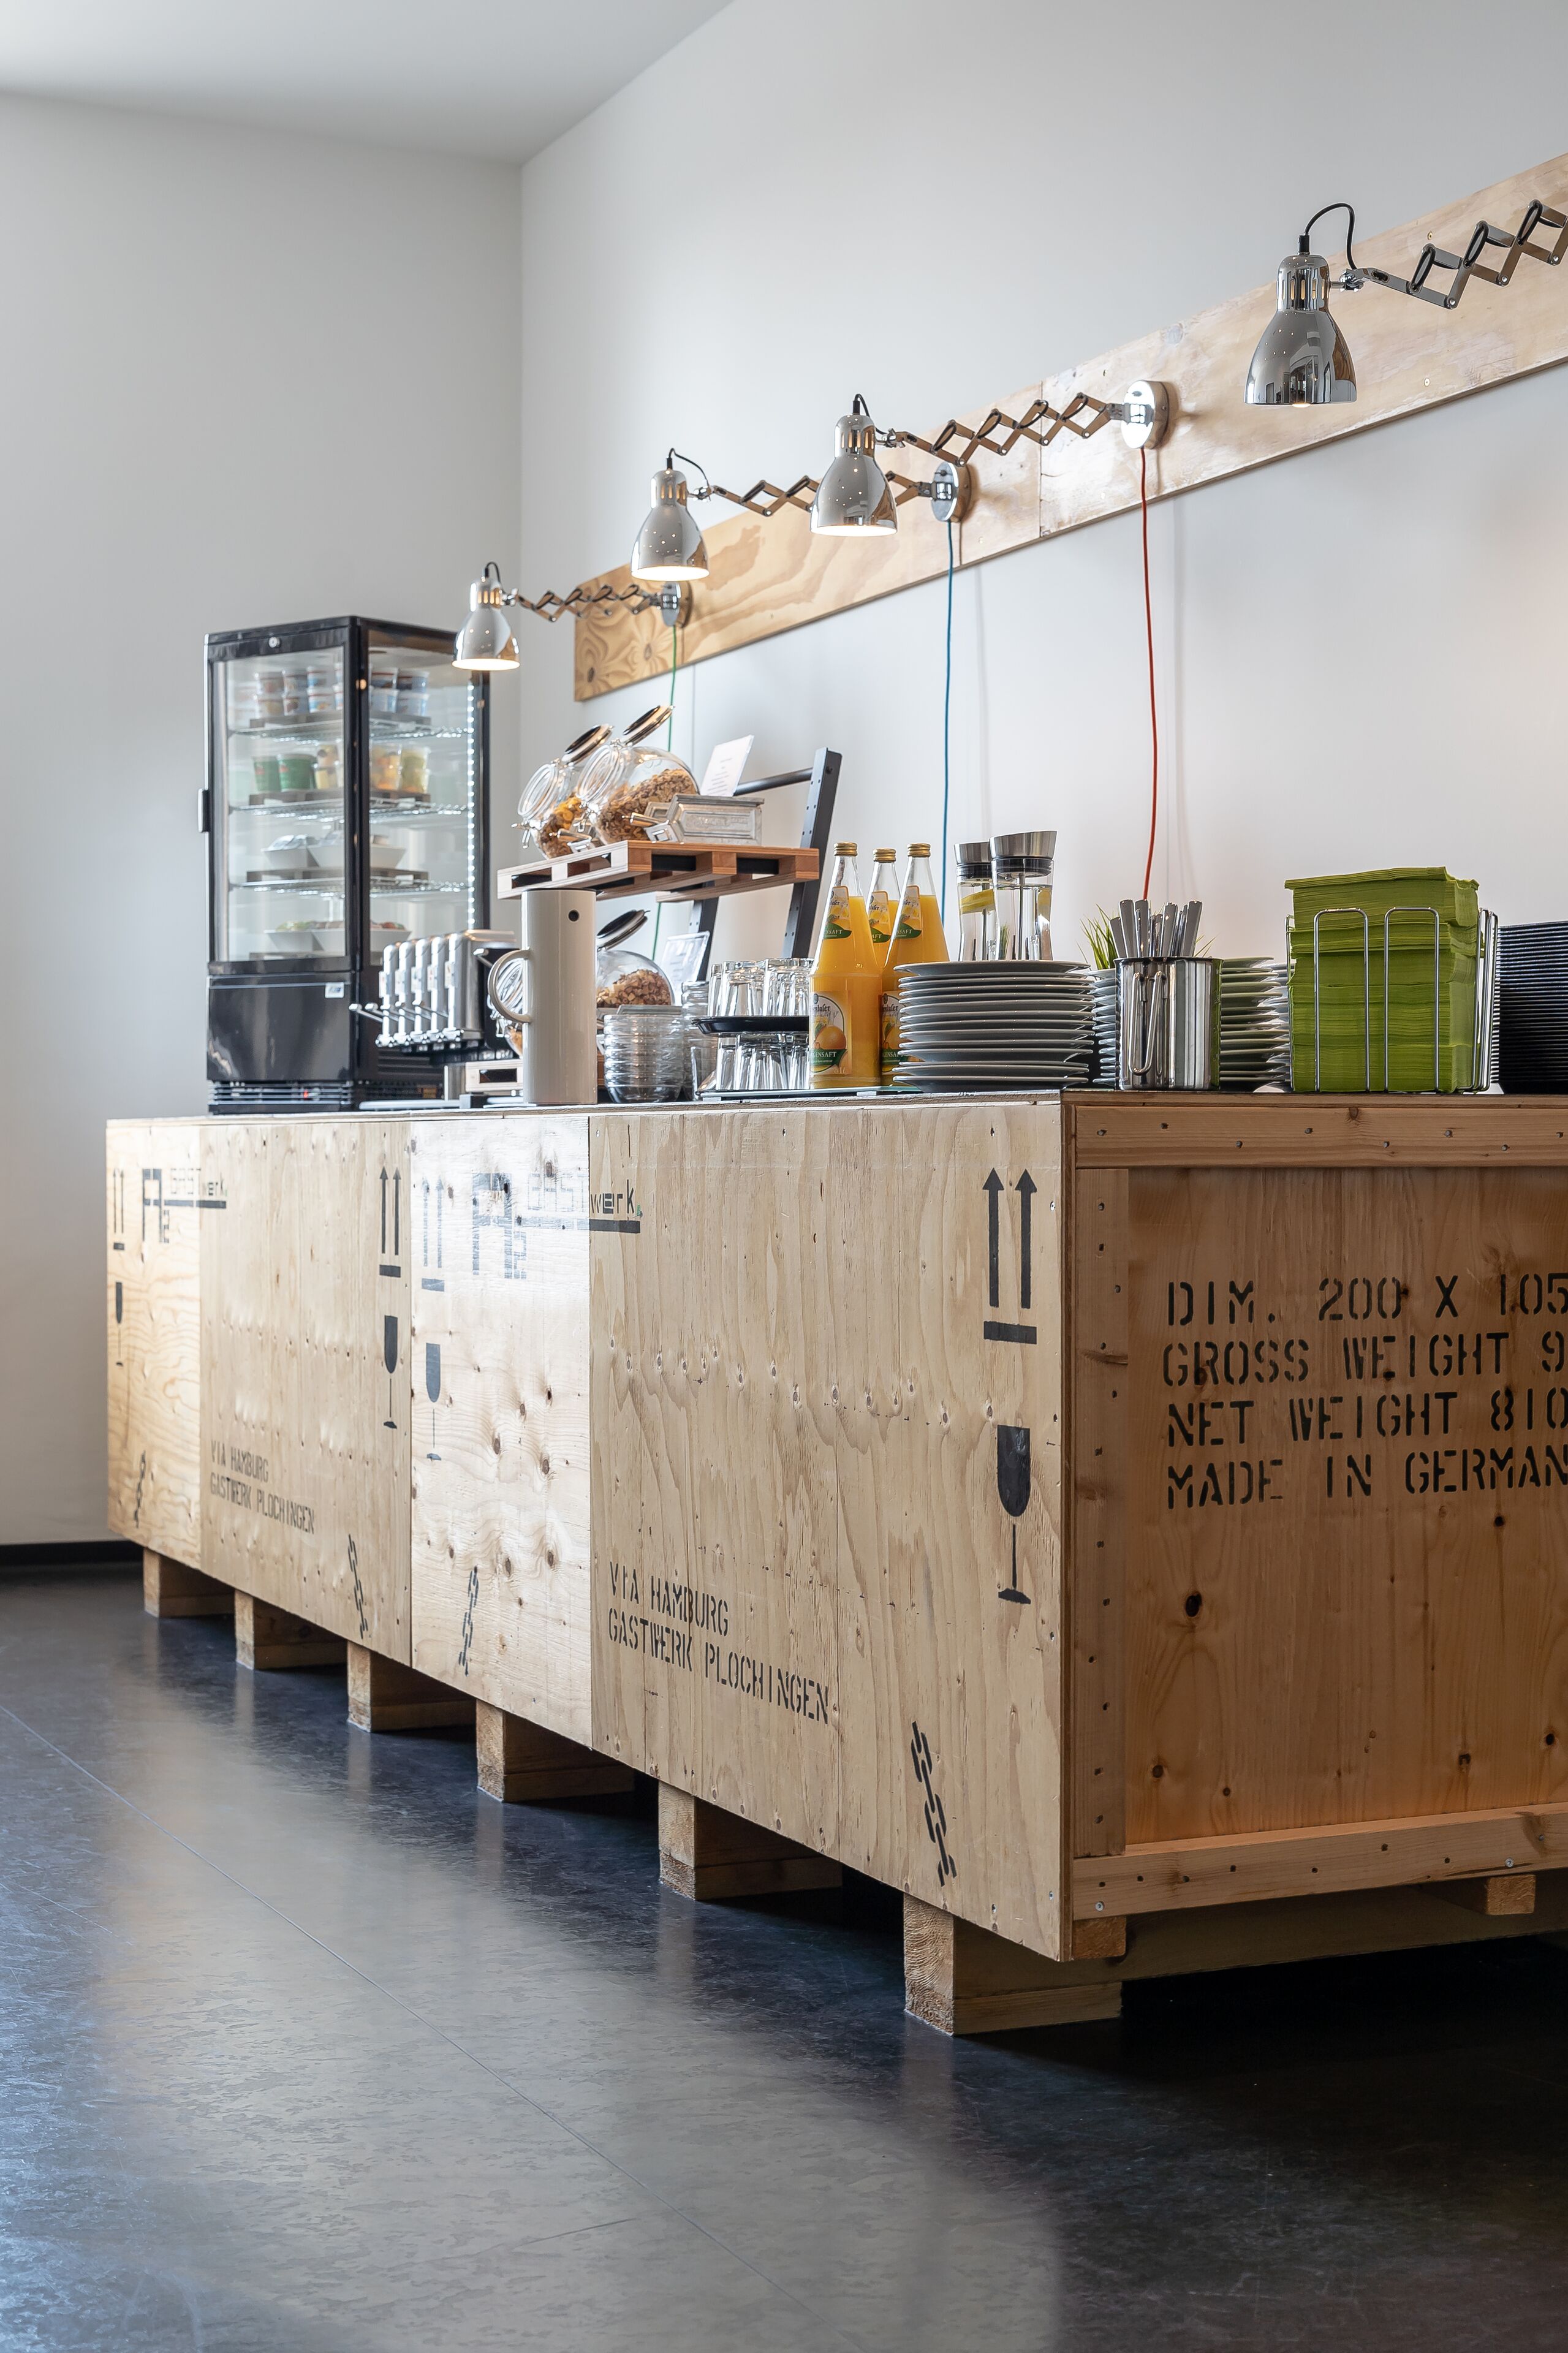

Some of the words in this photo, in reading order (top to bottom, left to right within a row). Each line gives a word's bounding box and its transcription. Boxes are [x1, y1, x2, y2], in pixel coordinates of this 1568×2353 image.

[1168, 1280, 1276, 1326] DIM.
[1319, 1277, 1401, 1321] 200
[1435, 1275, 1459, 1318] X
[1501, 1272, 1568, 1316] 105
[1164, 1339, 1309, 1386] GROSS
[1343, 1332, 1509, 1381] WEIGHT
[1542, 1331, 1565, 1373] 9
[1168, 1400, 1254, 1447] NET
[1289, 1391, 1458, 1442] WEIGHT
[211, 1439, 227, 1468] VIA
[231, 1446, 269, 1484] HAMBURG
[1168, 1459, 1283, 1510] MADE
[1327, 1453, 1371, 1498] IN
[1405, 1444, 1568, 1495] GERMAN
[210, 1472, 252, 1510] GASTWERK
[256, 1488, 315, 1536] PLOCHINGEN
[609, 1561, 640, 1604] VIA
[650, 1575, 729, 1637] HAMBURG
[608, 1607, 694, 1672] GASTWERK
[705, 1641, 829, 1726] PLOCHINGEN
